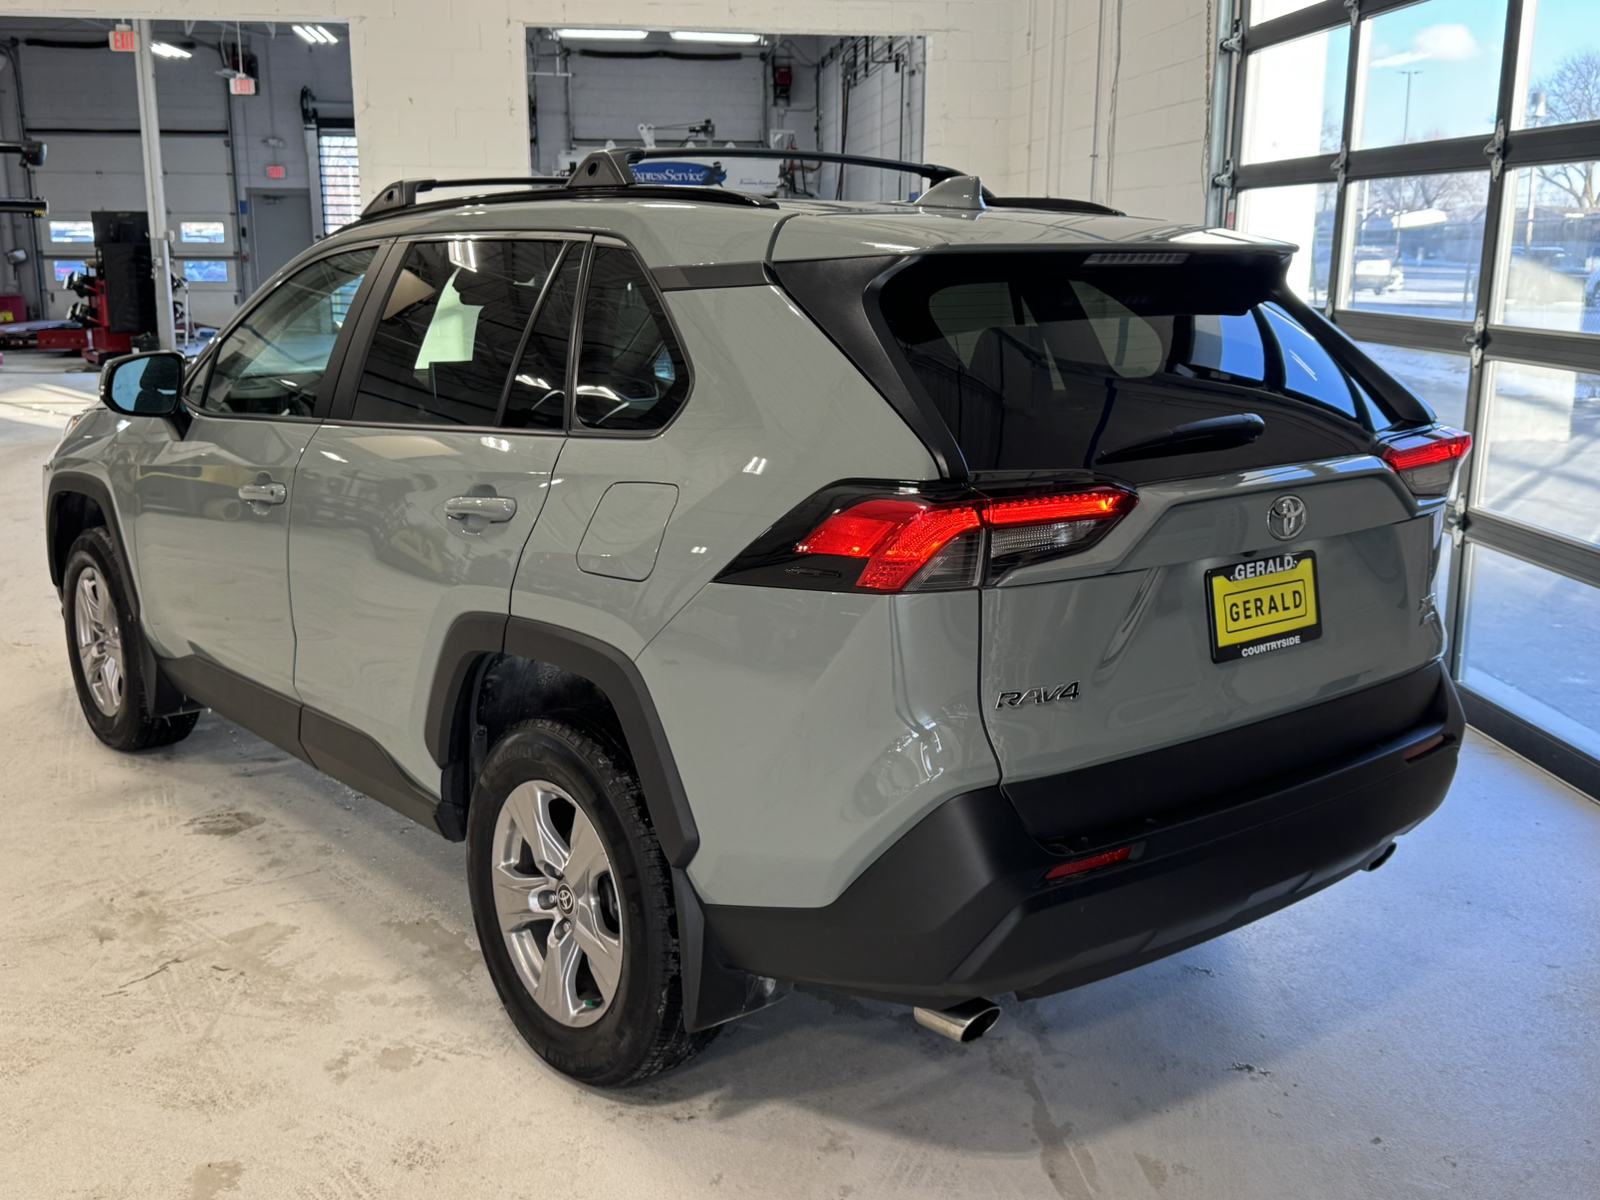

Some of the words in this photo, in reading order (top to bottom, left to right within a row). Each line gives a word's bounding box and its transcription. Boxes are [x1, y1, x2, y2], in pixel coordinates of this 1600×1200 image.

[114, 32, 134, 50] EXIT
[235, 79, 252, 94] EXIT
[1235, 555, 1293, 580] GERALD
[1229, 590, 1303, 622] GERALD
[1241, 635, 1301, 657] COUNTRYSIDE
[994, 680, 1080, 710] RAV4
